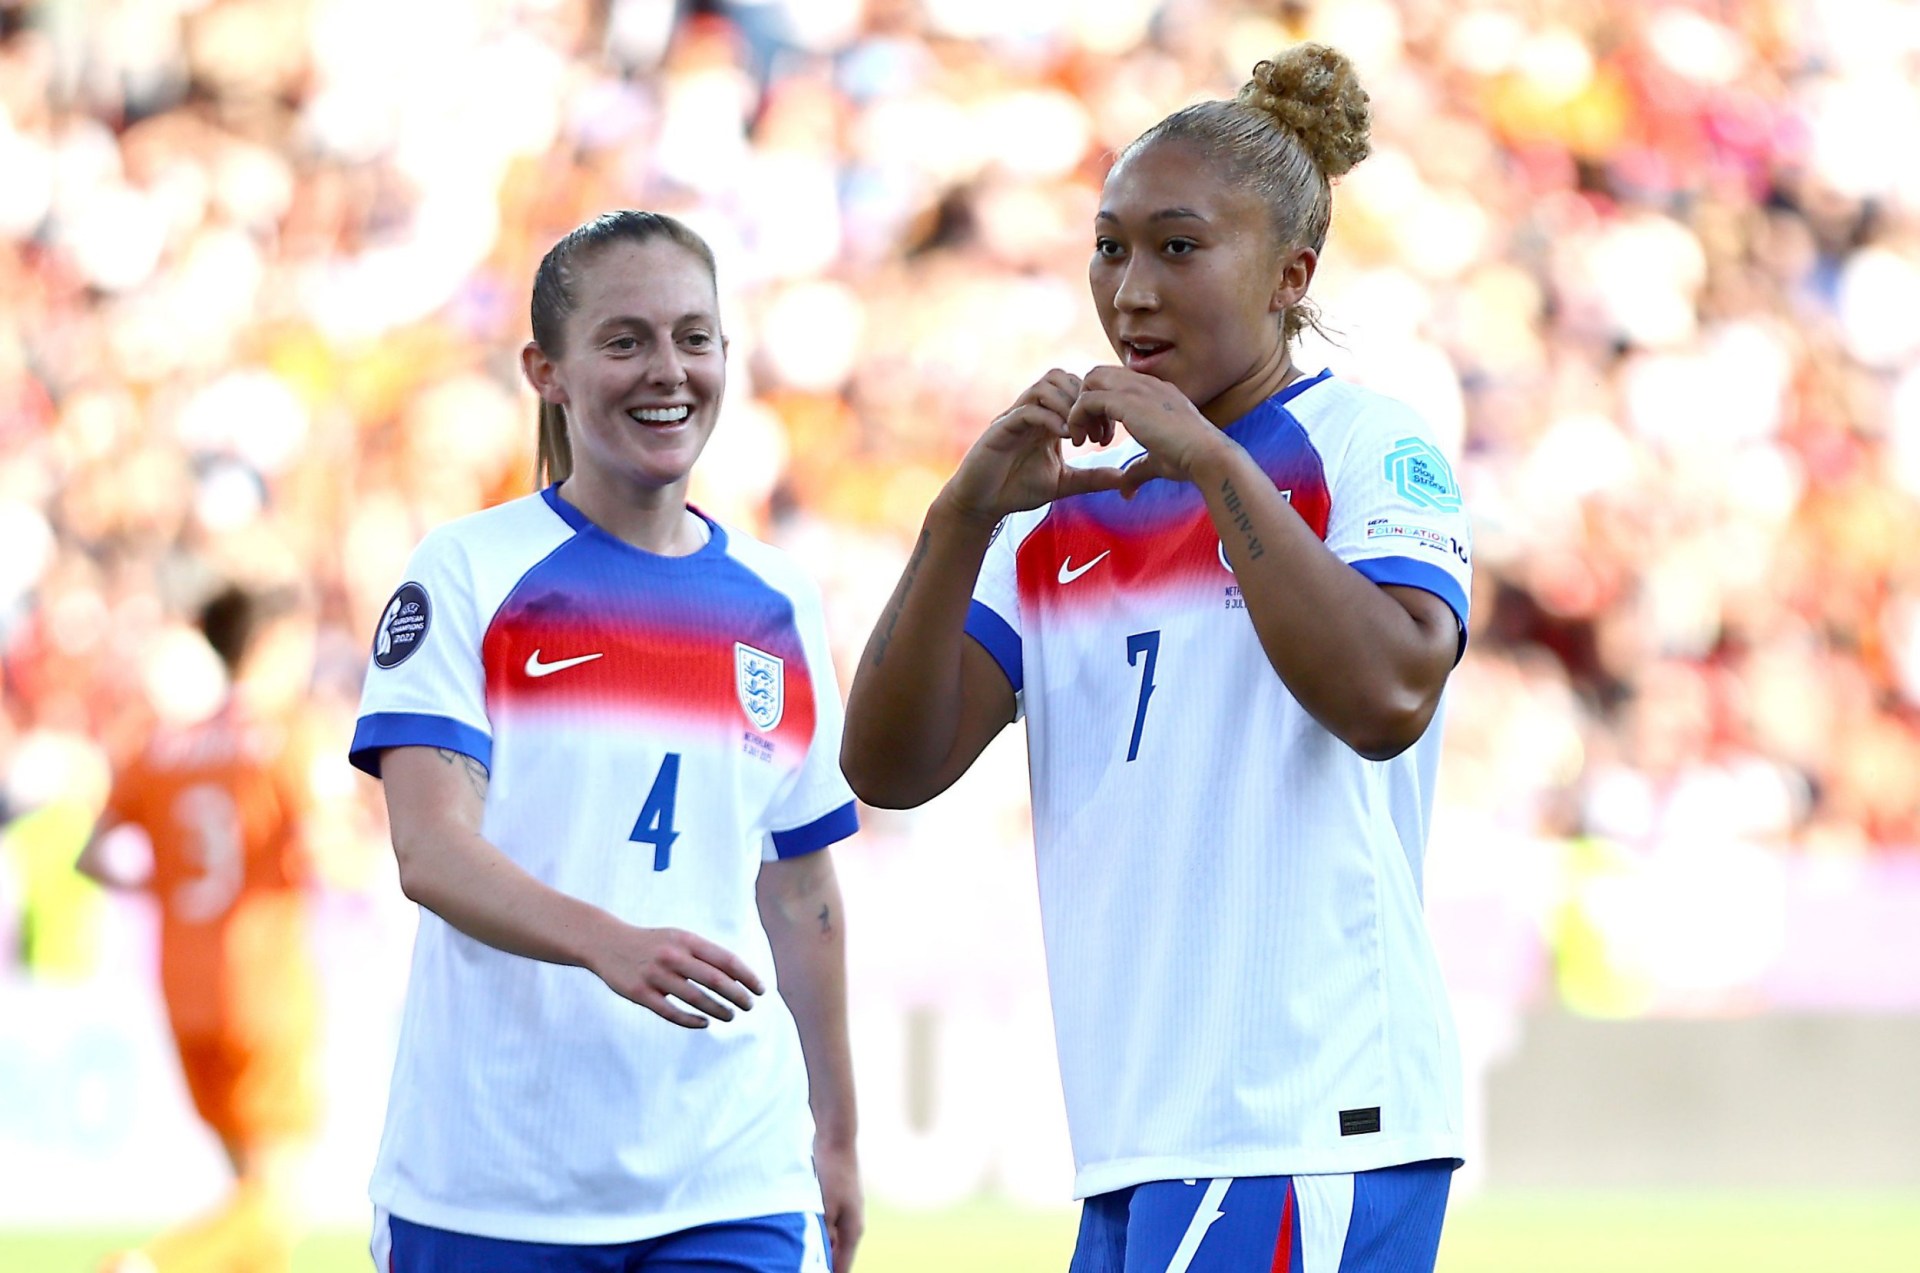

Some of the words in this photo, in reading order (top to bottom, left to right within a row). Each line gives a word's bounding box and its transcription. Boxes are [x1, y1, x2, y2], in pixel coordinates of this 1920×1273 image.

[1367, 527, 1448, 544] FOUNDATION
[1225, 599, 1230, 608] 9
[393, 632, 415, 644] 2022
[1126, 630, 1161, 762] 7
[628, 751, 681, 872] 4
